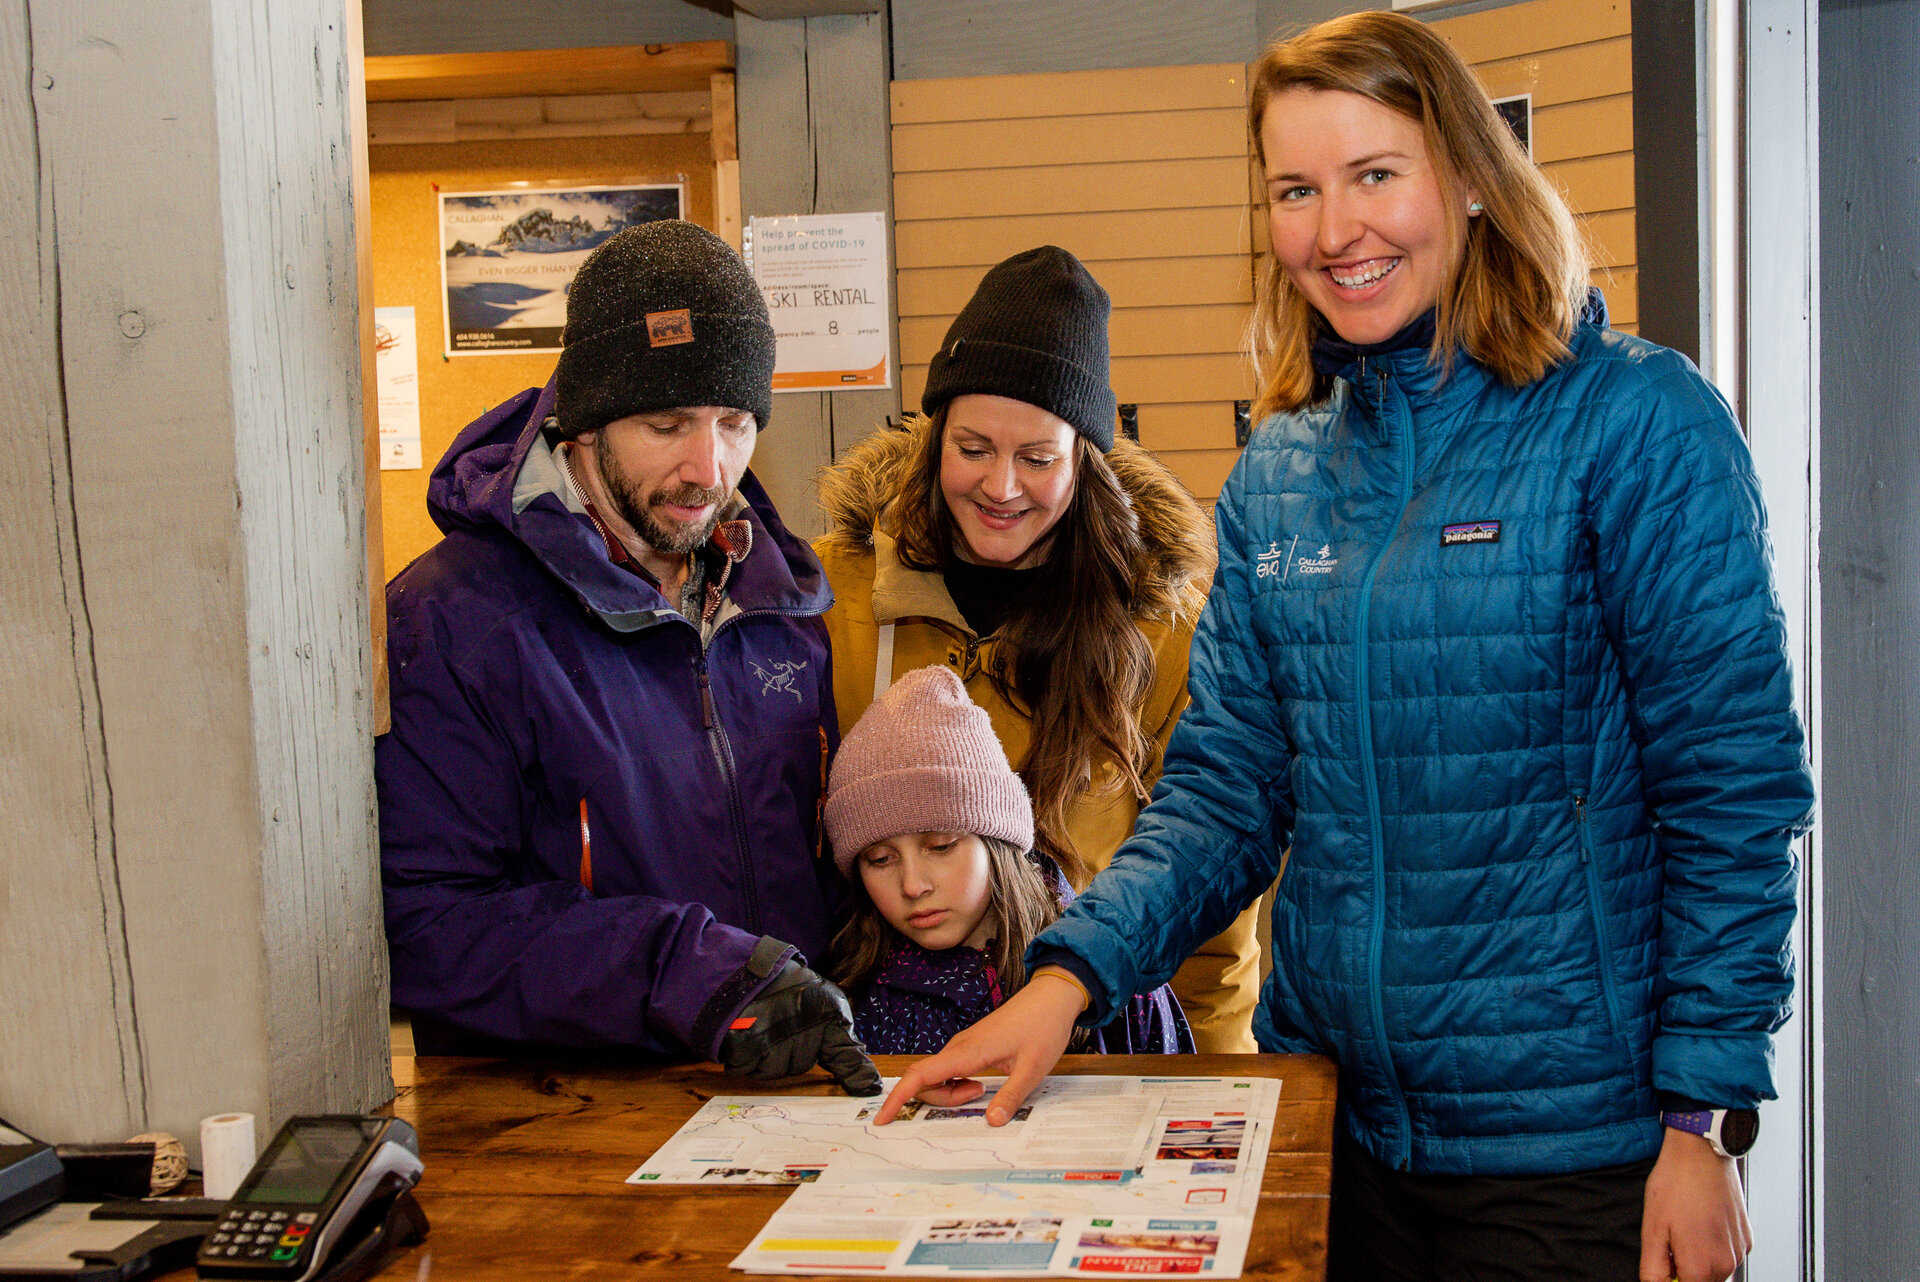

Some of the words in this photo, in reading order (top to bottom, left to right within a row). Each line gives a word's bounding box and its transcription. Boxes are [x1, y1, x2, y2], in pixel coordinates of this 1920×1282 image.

[762, 231, 784, 240] Help
[788, 229, 824, 238] prvent
[828, 227, 843, 235] the
[762, 244, 795, 253] spread
[799, 242, 808, 250] of
[812, 240, 865, 250] COVID-19
[479, 267, 502, 276] EVEN
[505, 266, 538, 275] BIGGER
[541, 264, 567, 274] THAN
[770, 292, 798, 309] SKI
[814, 288, 876, 307] RENTAL
[828, 320, 839, 336] 8
[858, 327, 880, 335] people
[1444, 531, 1494, 544] patagonia
[1256, 559, 1280, 578] evo
[1299, 565, 1333, 574] COUNTRY
